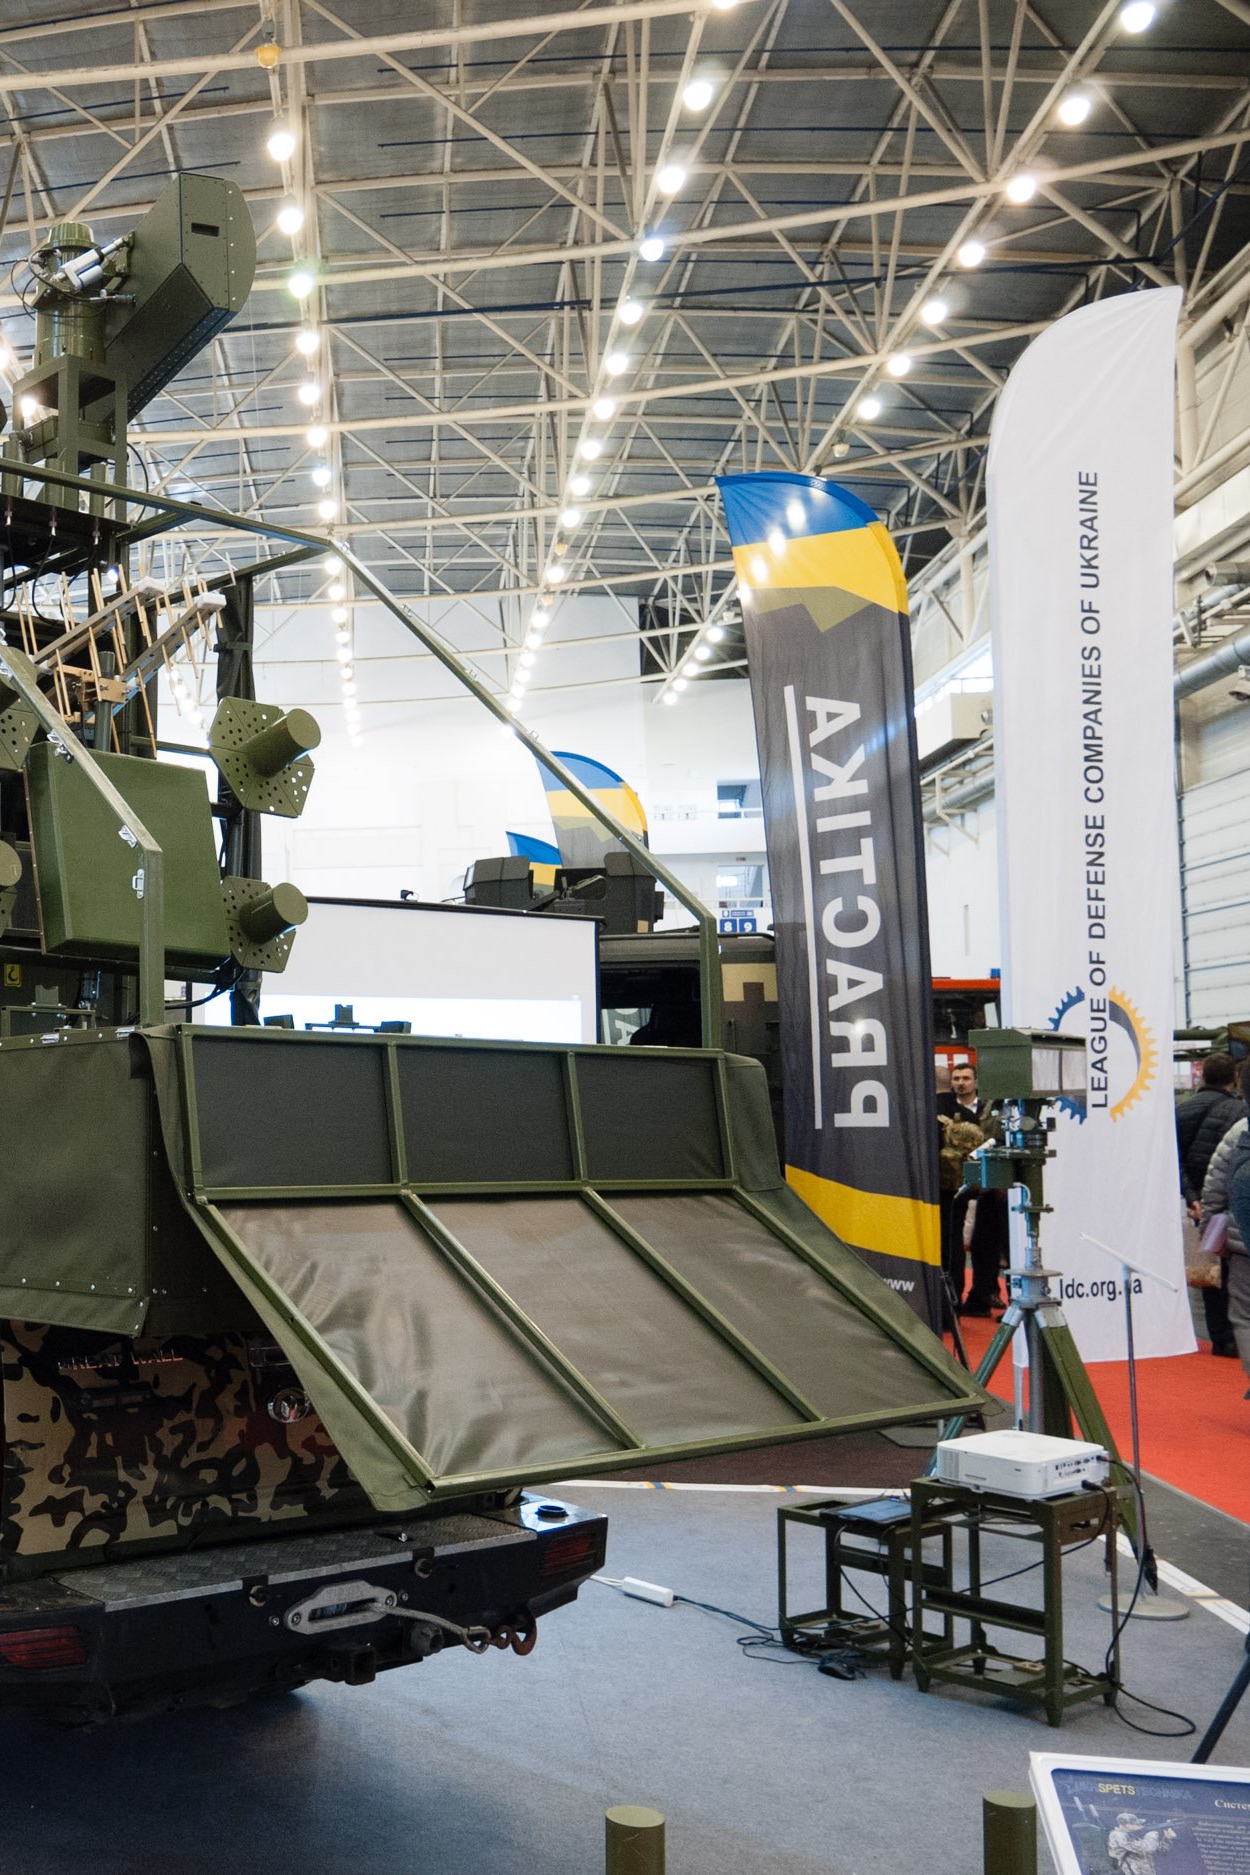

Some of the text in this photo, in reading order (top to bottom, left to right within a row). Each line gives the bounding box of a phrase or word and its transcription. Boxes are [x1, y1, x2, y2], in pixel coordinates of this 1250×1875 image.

[1078, 471, 1108, 1108] LEAGUE OF DEFENSE COMPANIES OF UKRAINE
[724, 921, 753, 932] 8 9
[1059, 1278, 1143, 1301] ldc.org.a
